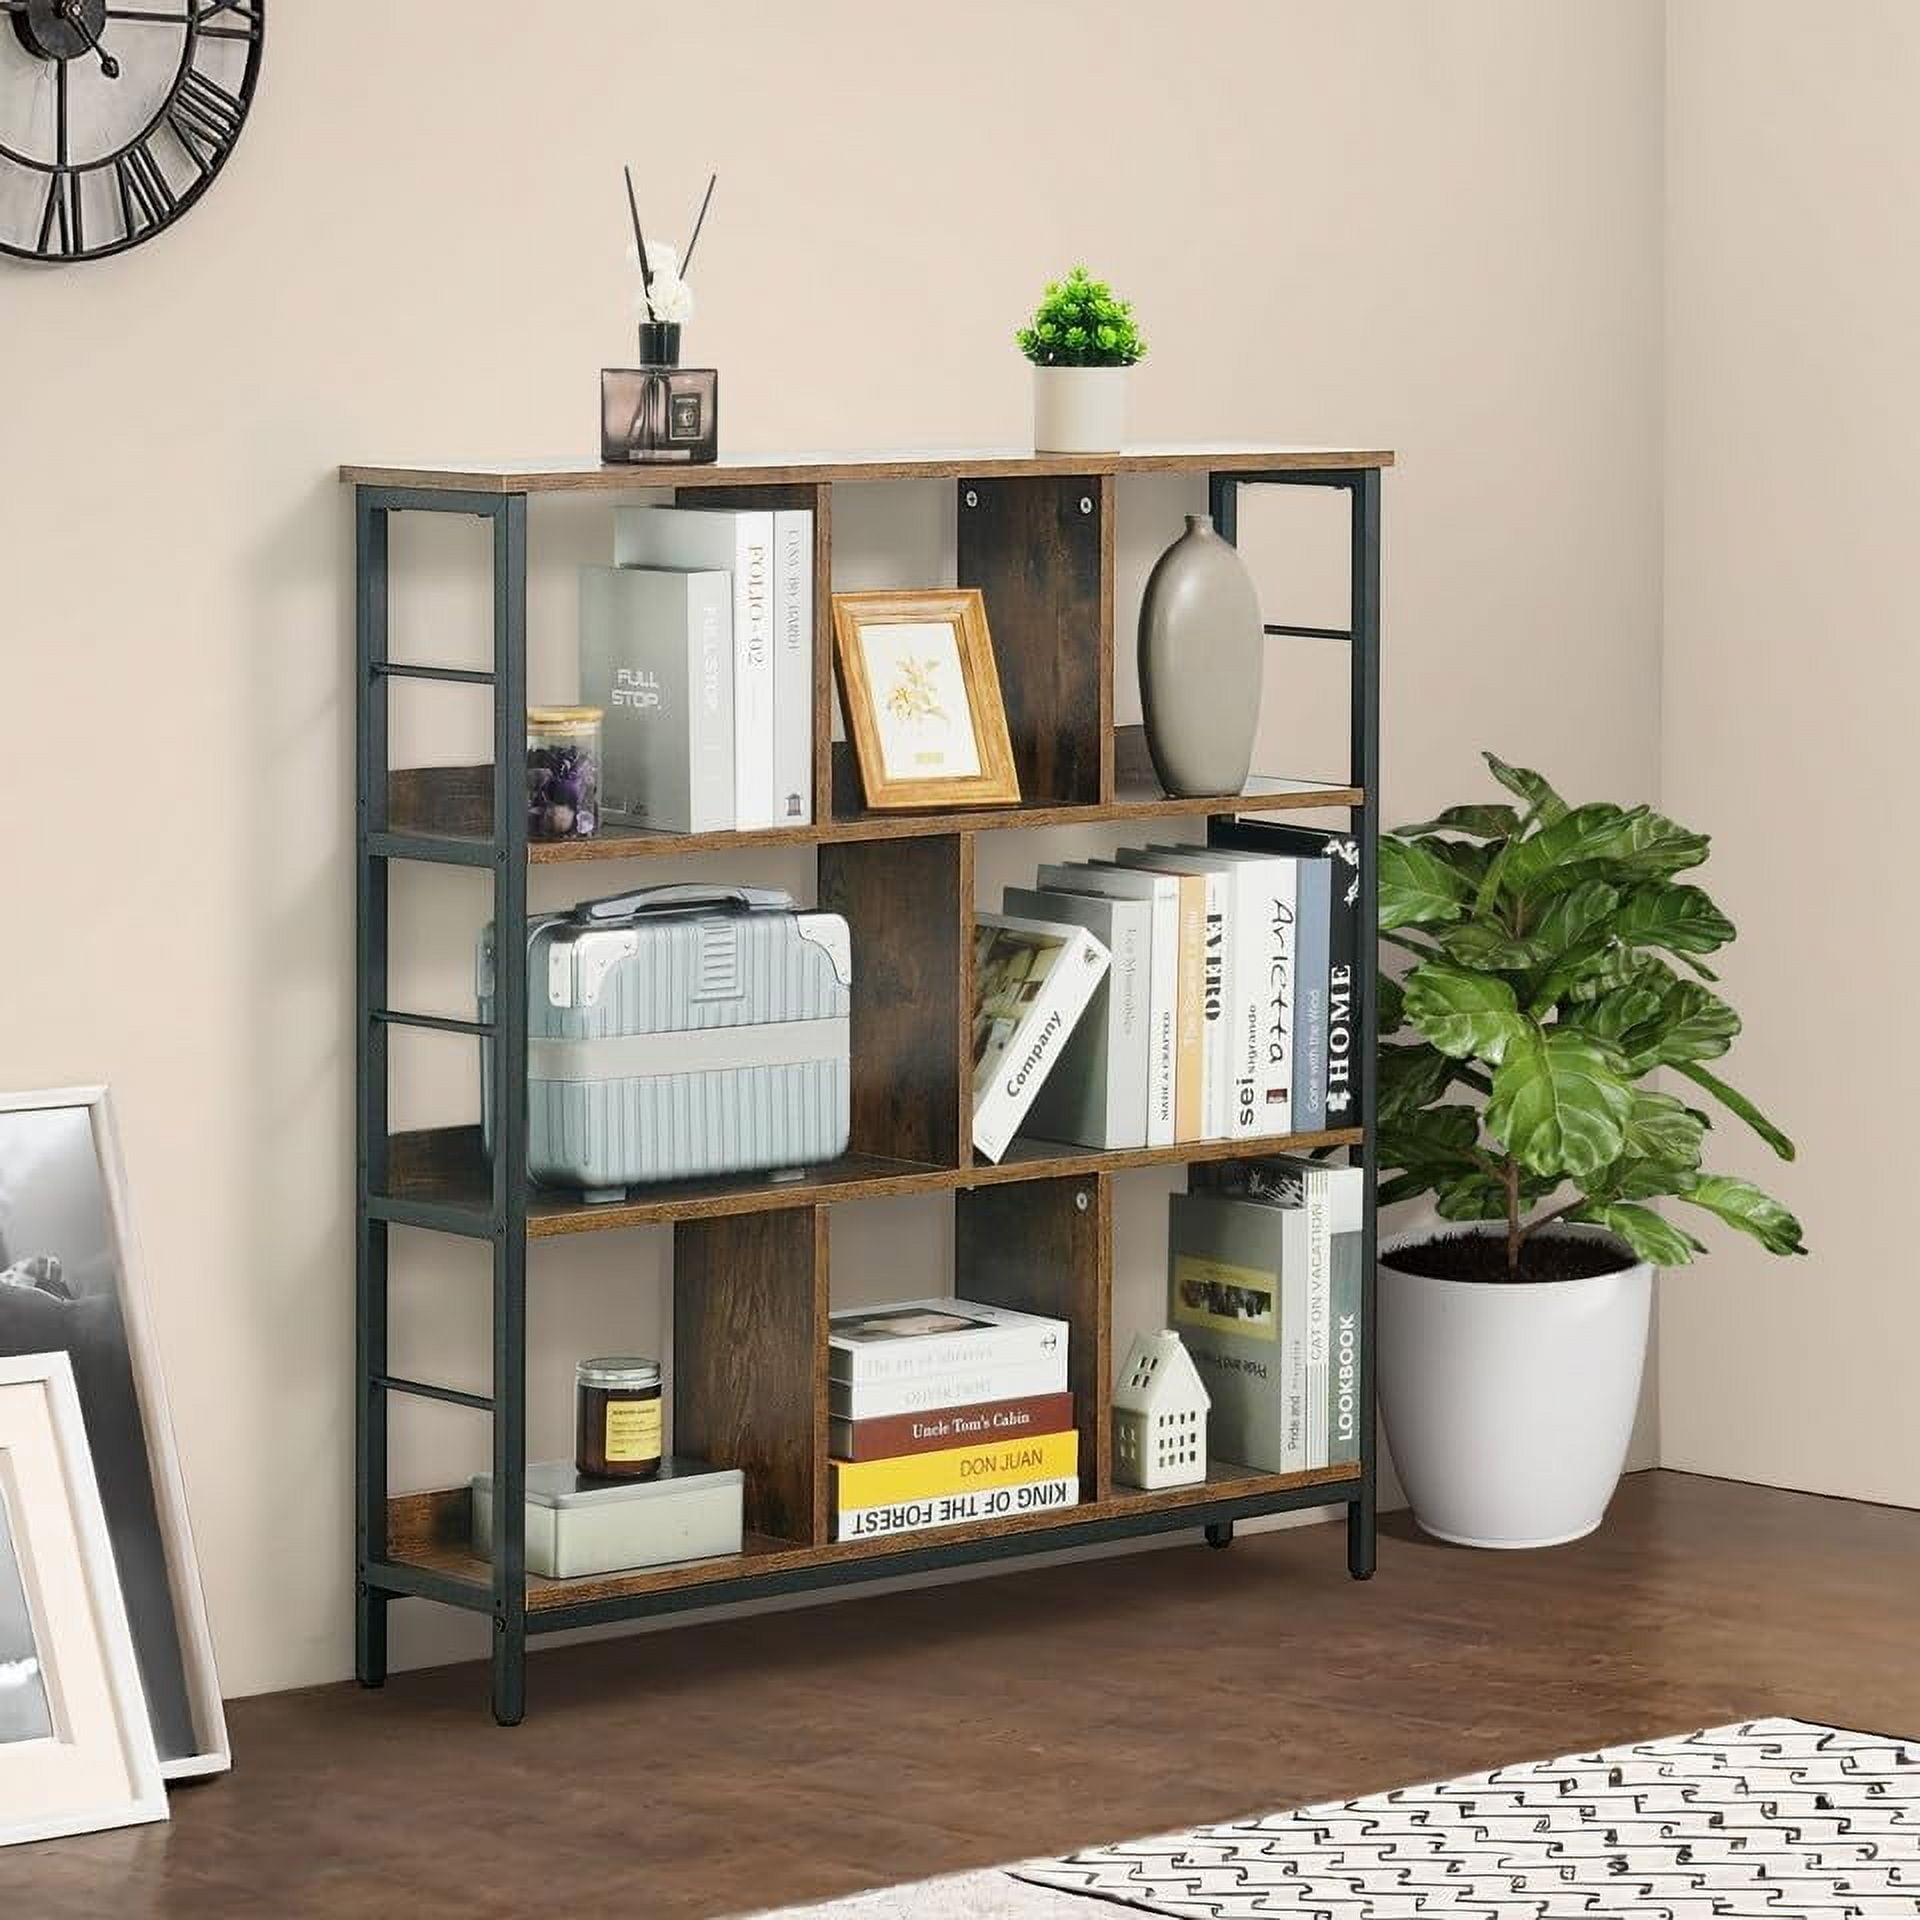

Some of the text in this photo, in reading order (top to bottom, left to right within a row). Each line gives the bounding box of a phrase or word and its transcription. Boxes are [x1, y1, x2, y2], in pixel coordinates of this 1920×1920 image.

[615, 669, 659, 688] FULL
[1329, 965, 1351, 1083] HOME
[1006, 1009, 1063, 1098] Company
[1236, 1078, 1254, 1126] sei
[1311, 1202, 1322, 1361] CAT ON VACATION
[1338, 1312, 1355, 1441] LOOKBOOK
[911, 1410, 1030, 1439] Uncle Tom's Cabin
[960, 1449, 1043, 1477] DON JUAN
[851, 1481, 1067, 1535] KING OF THE FOREST
